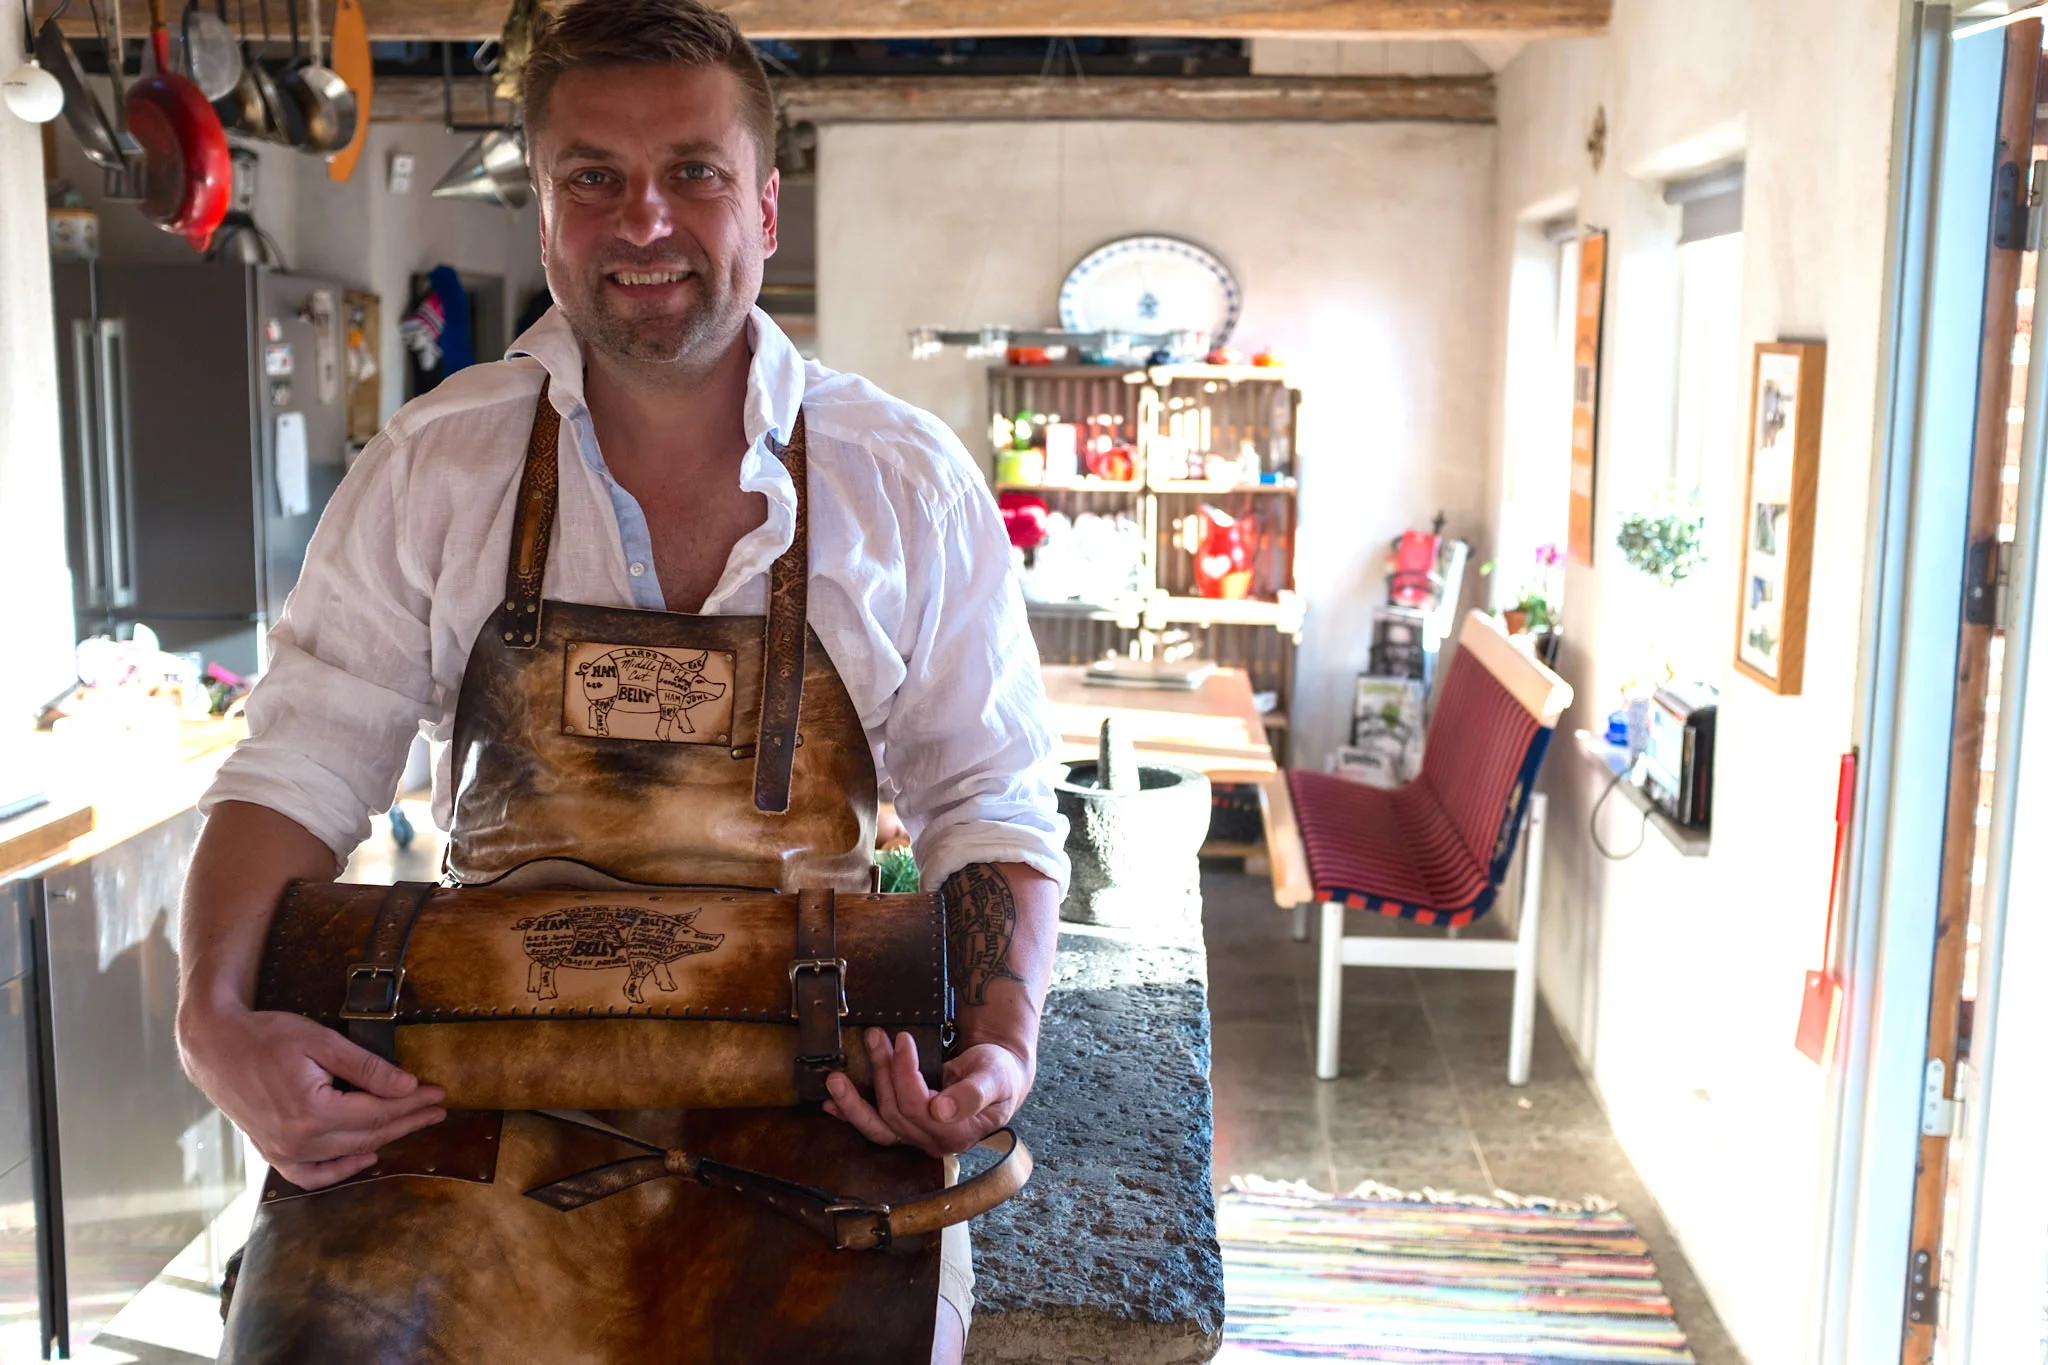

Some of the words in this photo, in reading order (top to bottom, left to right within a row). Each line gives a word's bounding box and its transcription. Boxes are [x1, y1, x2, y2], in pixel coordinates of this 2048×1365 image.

[625, 649, 657, 659] LARDO
[621, 658, 658, 672] Middle
[663, 662, 690, 678] BUTT
[688, 660, 703, 670] EAR
[591, 665, 616, 678] HAM
[628, 670, 652, 682] Cut
[618, 686, 656, 704] BELLY
[664, 692, 682, 704] HAM
[686, 694, 709, 705] JOWL
[535, 918, 570, 931] HAM
[638, 918, 681, 930] BUTT
[569, 940, 627, 957] BELLY
